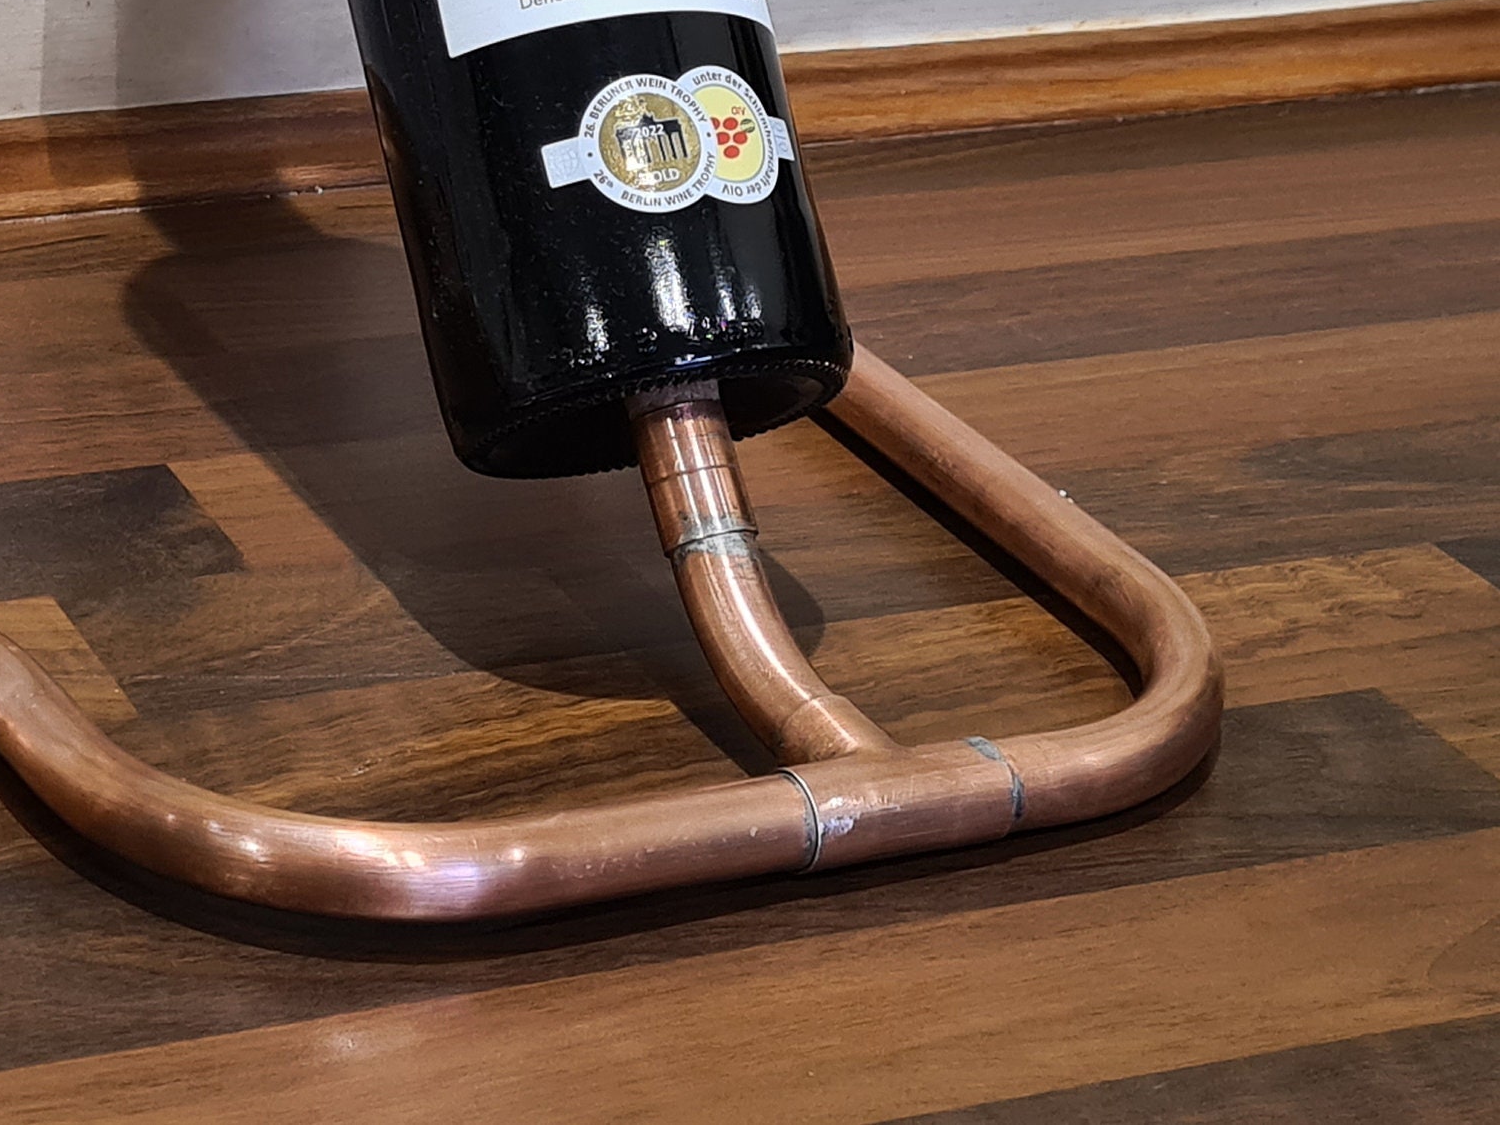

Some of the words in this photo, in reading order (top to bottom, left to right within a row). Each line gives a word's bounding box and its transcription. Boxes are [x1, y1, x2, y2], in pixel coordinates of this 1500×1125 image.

[635, 78, 667, 91] WEIN
[669, 81, 708, 123] TROPHY
[634, 124, 665, 137] 2022
[620, 190, 662, 207] BERLIN
[664, 190, 694, 206] WINE
[693, 151, 717, 196] TROPHY
